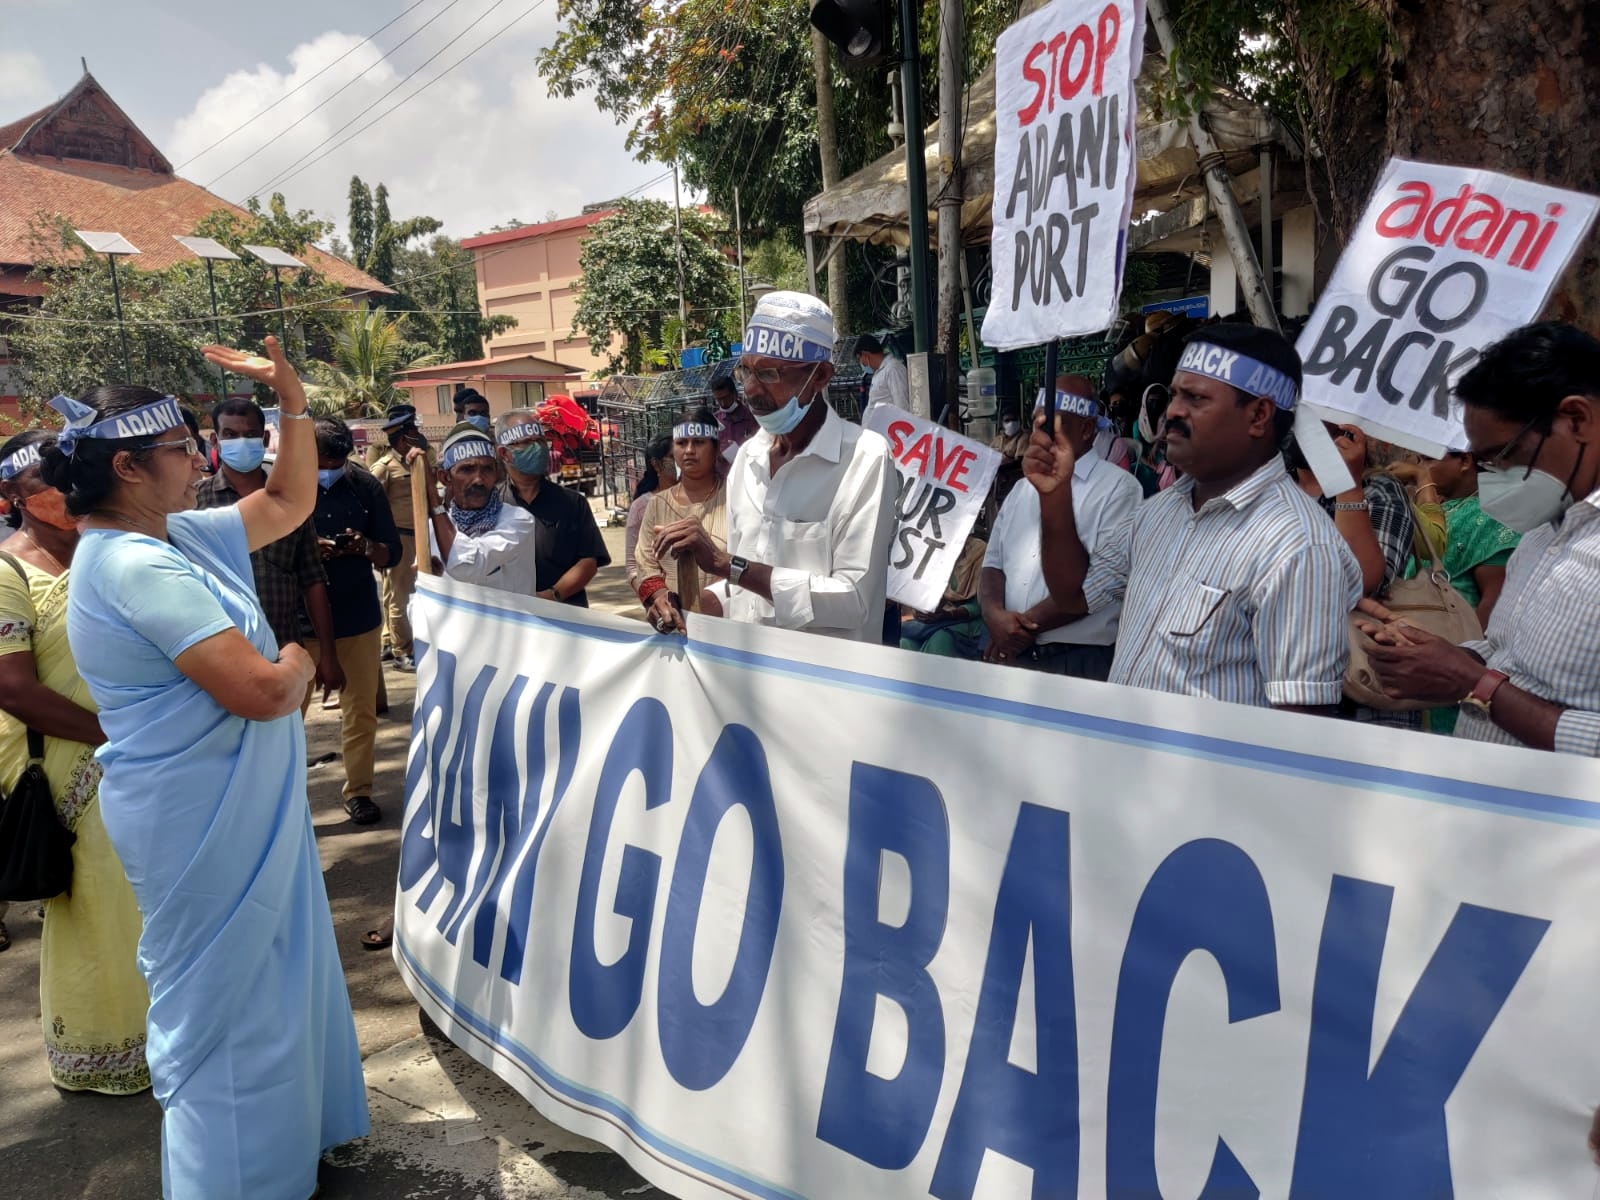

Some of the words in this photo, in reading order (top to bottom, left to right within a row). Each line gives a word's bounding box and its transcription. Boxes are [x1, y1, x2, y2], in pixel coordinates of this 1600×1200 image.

[1017, 3, 1121, 127] STOP
[1005, 94, 1120, 227] ADANI
[1011, 202, 1099, 312] PORT
[1375, 180, 1566, 272] adani
[1367, 245, 1489, 333] GO
[757, 329, 805, 359] BACK
[1182, 341, 1239, 380] BACK
[1303, 304, 1480, 421] BACK
[115, 402, 178, 438] ADANI
[500, 425, 524, 445] ADANI
[525, 423, 540, 436] GO
[687, 423, 702, 437] GO
[1060, 393, 1092, 416] BACK
[11, 442, 42, 471] ADA
[453, 441, 487, 462] ADANI
[887, 420, 978, 493] SAVE
[894, 470, 957, 539] UR
[887, 526, 947, 581] ST
[568, 696, 785, 1092] GO
[816, 760, 1553, 1200] BACK
